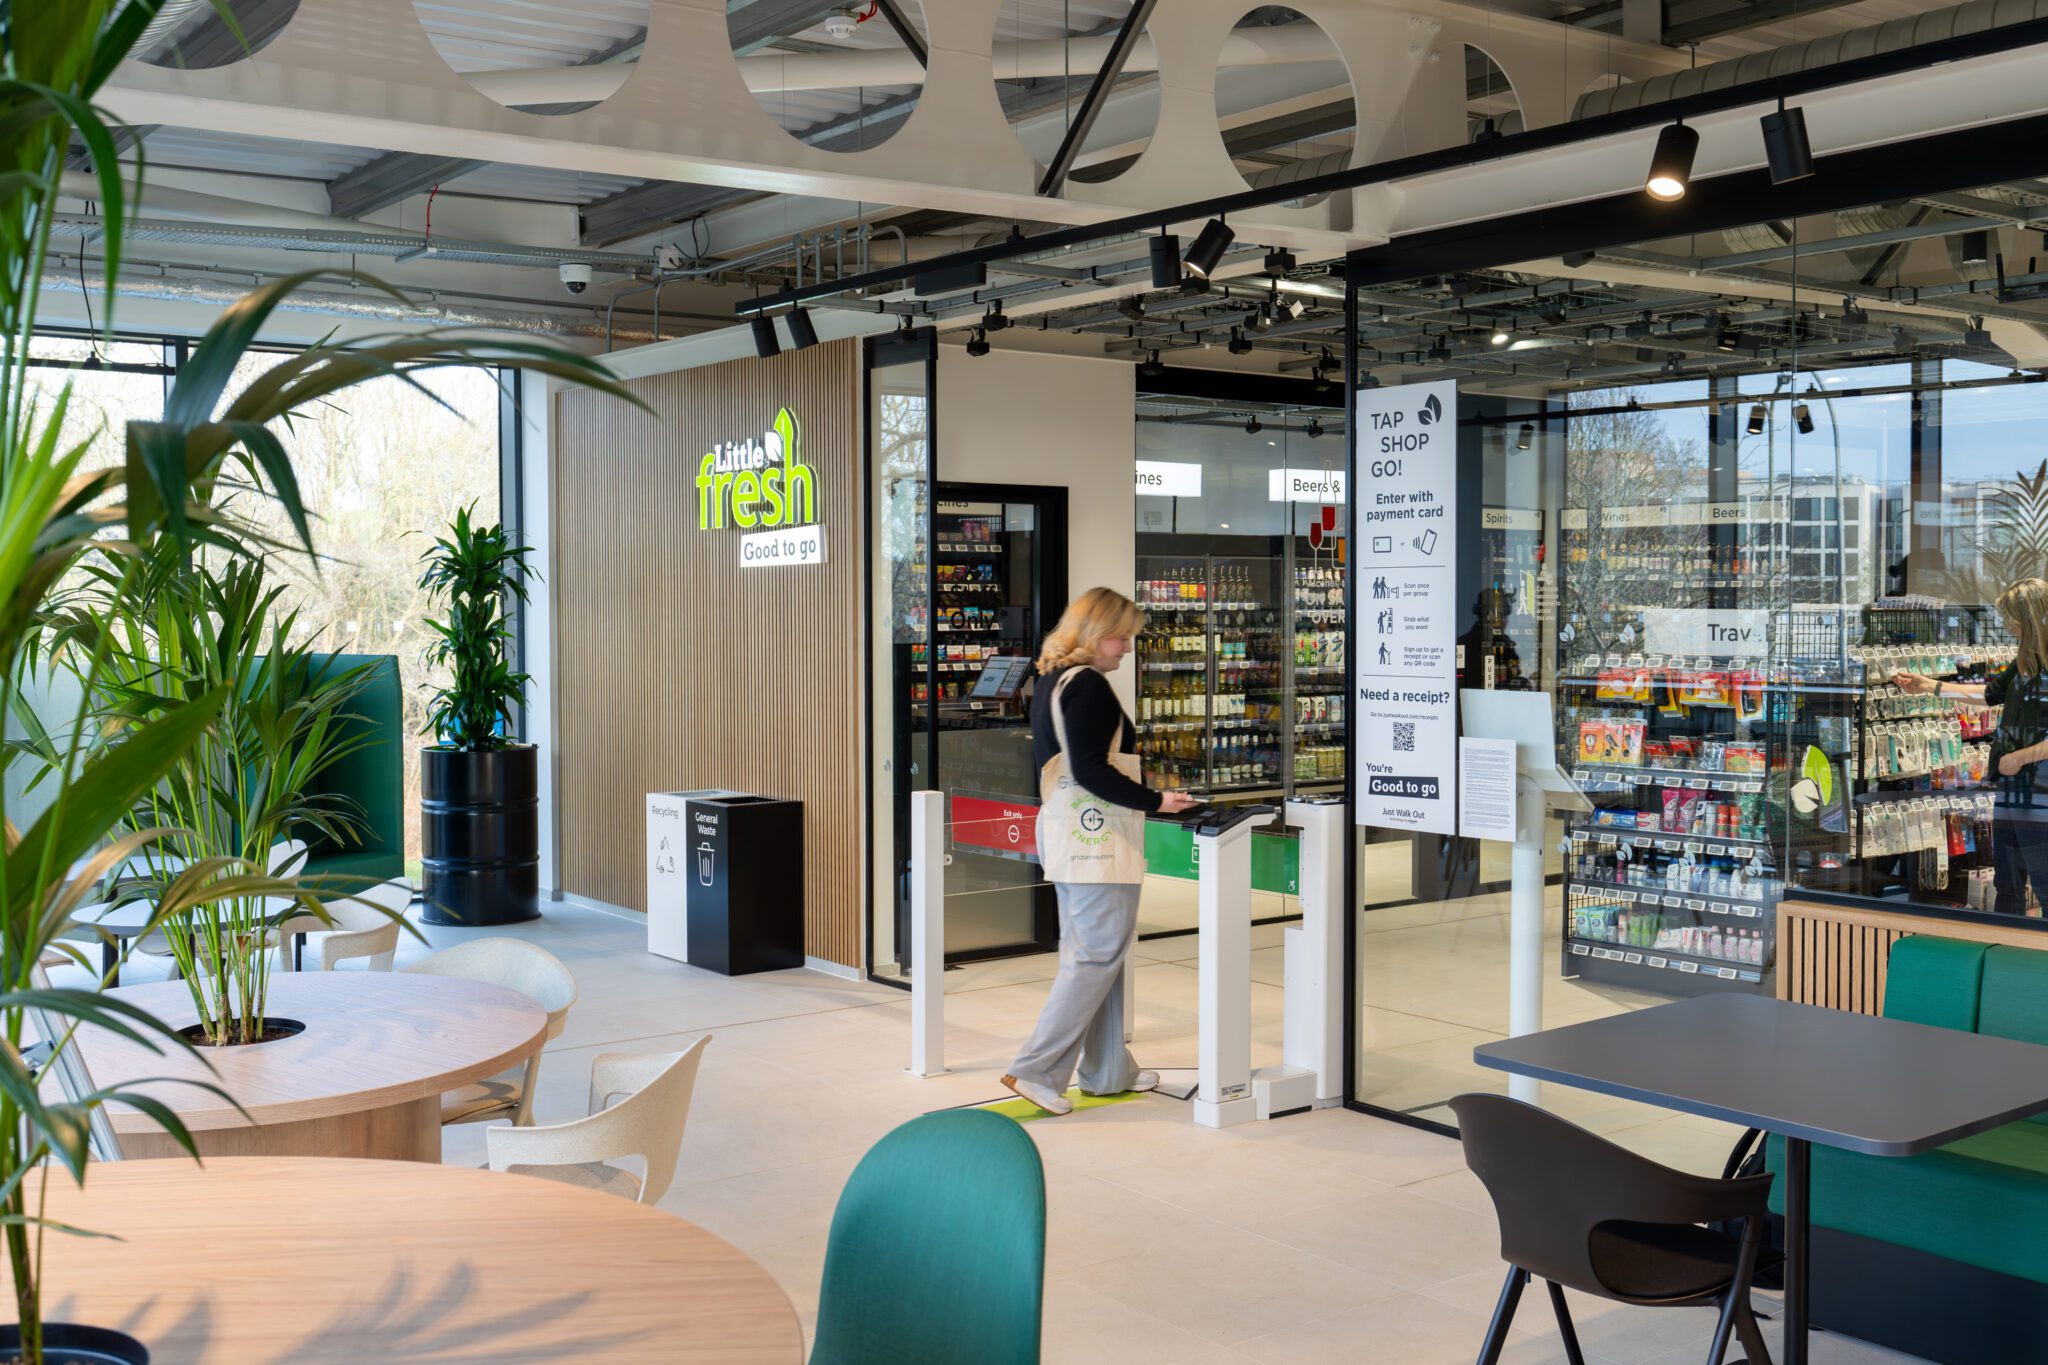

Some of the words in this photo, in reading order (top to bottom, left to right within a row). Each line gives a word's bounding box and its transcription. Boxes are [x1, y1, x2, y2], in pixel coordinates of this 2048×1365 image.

[1371, 411, 1404, 430] TAP
[1381, 433, 1429, 453] SHOP
[715, 438, 764, 472] Little
[696, 406, 819, 530] fresh
[1371, 460, 1402, 478] GO!
[1293, 478, 1328, 492] Beers
[1333, 480, 1341, 493] &
[1376, 493, 1406, 505] Enter
[1409, 490, 1433, 503] with
[1367, 507, 1414, 523] payment
[1418, 505, 1443, 518] card
[1486, 512, 1513, 525] Spirits
[1712, 507, 1746, 519] Beers
[744, 538, 779, 560] Good
[783, 540, 796, 556] to
[800, 539, 816, 560] go
[1360, 688, 1390, 700] Need
[1393, 692, 1399, 701] a
[1402, 691, 1450, 705] receipt?
[1366, 762, 1393, 774] You're
[1371, 779, 1404, 793] Good
[1406, 781, 1418, 793] to
[1421, 784, 1437, 797] go
[651, 805, 679, 820] Recycling
[695, 812, 718, 824] General
[1003, 809, 1012, 817] Exit
[1012, 811, 1023, 820] only
[1382, 807, 1395, 816] Just
[1396, 809, 1412, 817] Walk
[1412, 810, 1425, 819] Out
[697, 824, 717, 836] Waste
[1071, 828, 1113, 845] ENERGY
